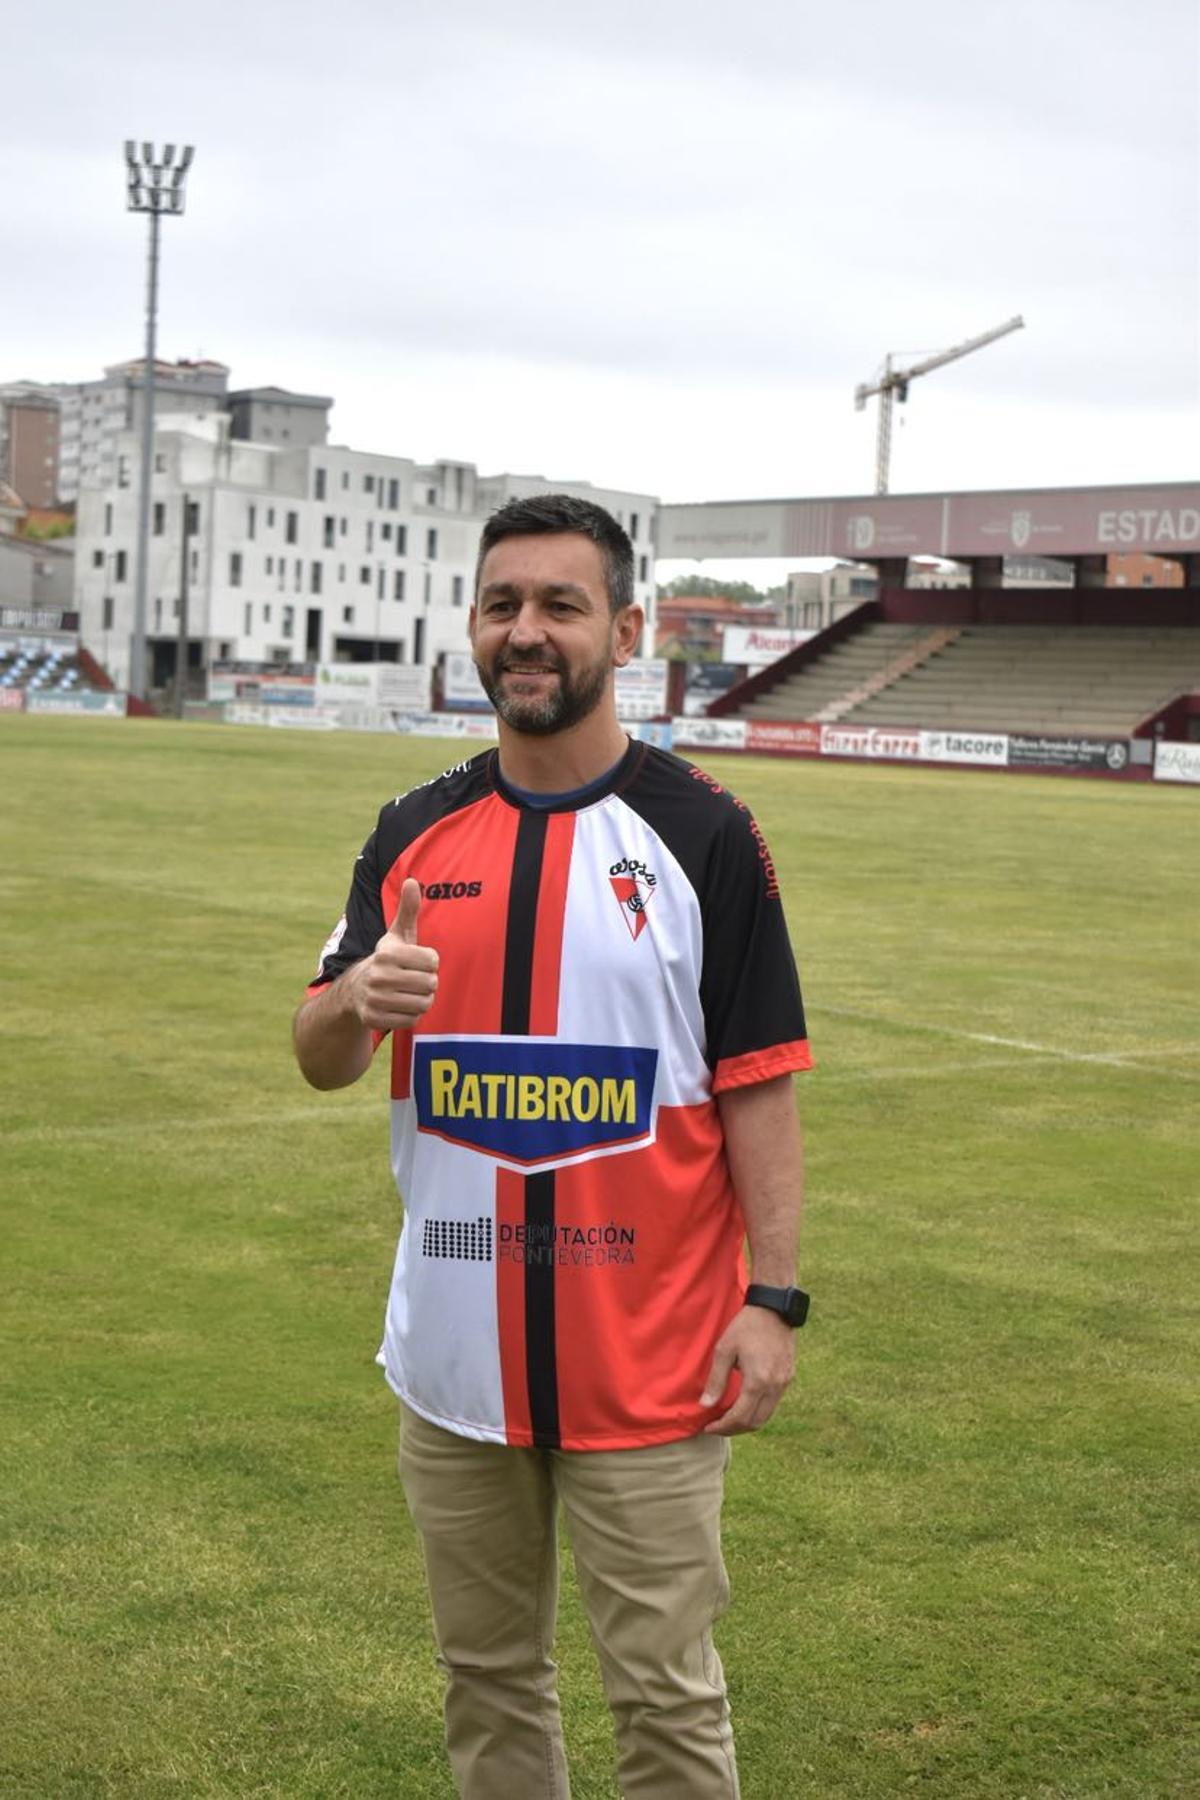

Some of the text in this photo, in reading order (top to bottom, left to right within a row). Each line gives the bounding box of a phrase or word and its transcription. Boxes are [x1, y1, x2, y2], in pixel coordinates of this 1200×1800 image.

[1097, 508, 1200, 543] ESTAD
[945, 734, 1004, 756] tacore
[430, 1058, 637, 1125] RATIBROM
[500, 1221, 636, 1246] DEPUTACIÓN
[499, 1246, 636, 1267] PONTEVEDRA
